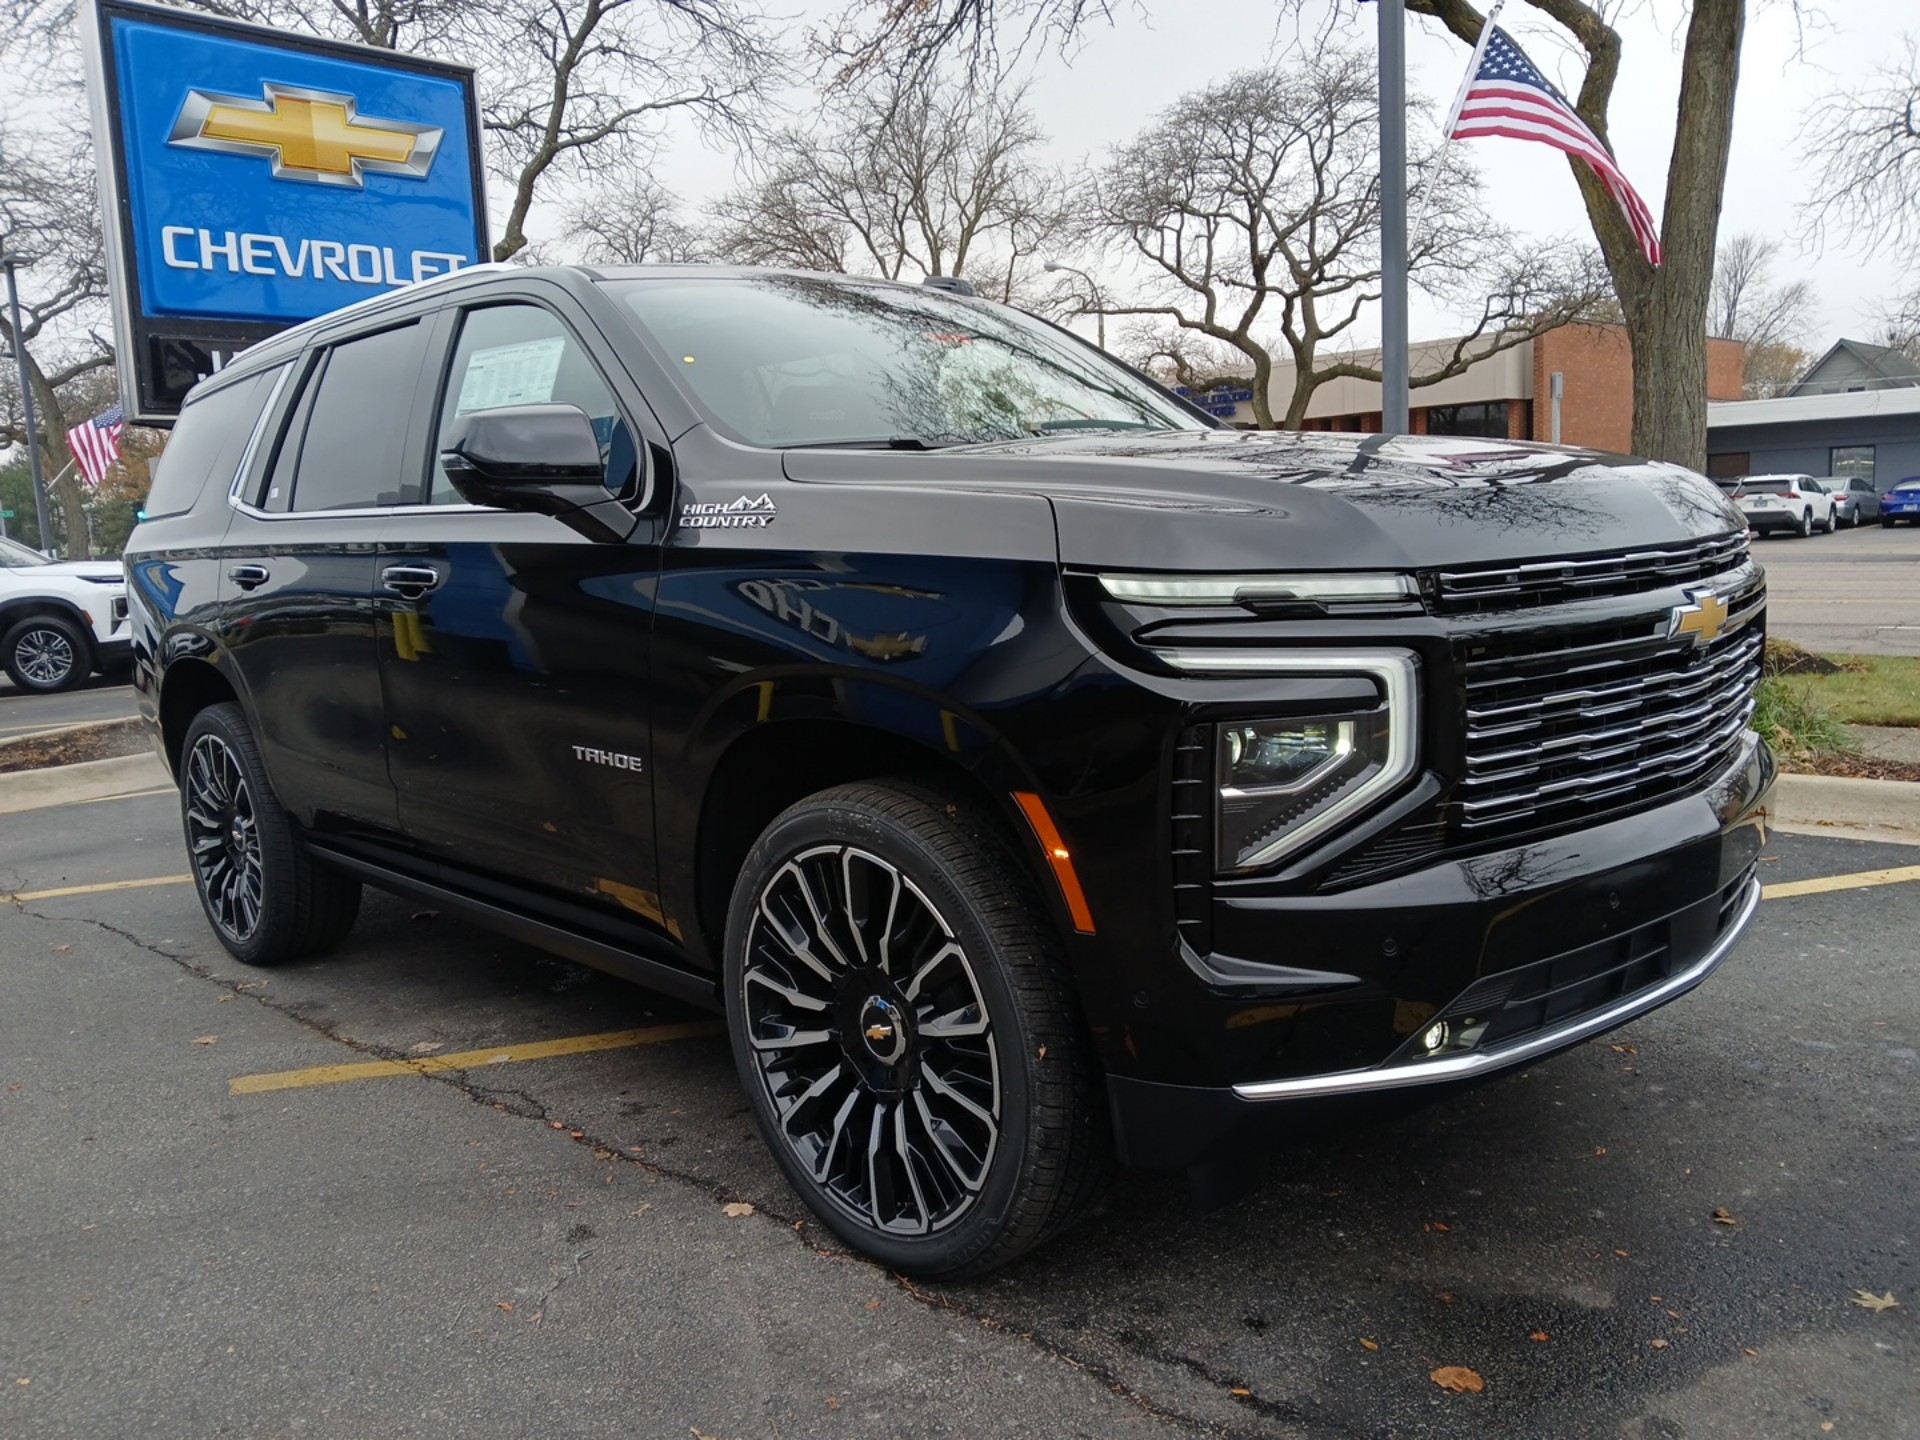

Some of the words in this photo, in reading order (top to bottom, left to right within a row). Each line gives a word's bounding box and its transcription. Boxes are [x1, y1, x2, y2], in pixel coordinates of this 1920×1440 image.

[683, 503, 729, 515] HIGH
[680, 515, 775, 528] COUNTRY
[572, 745, 642, 772] TAHOE
